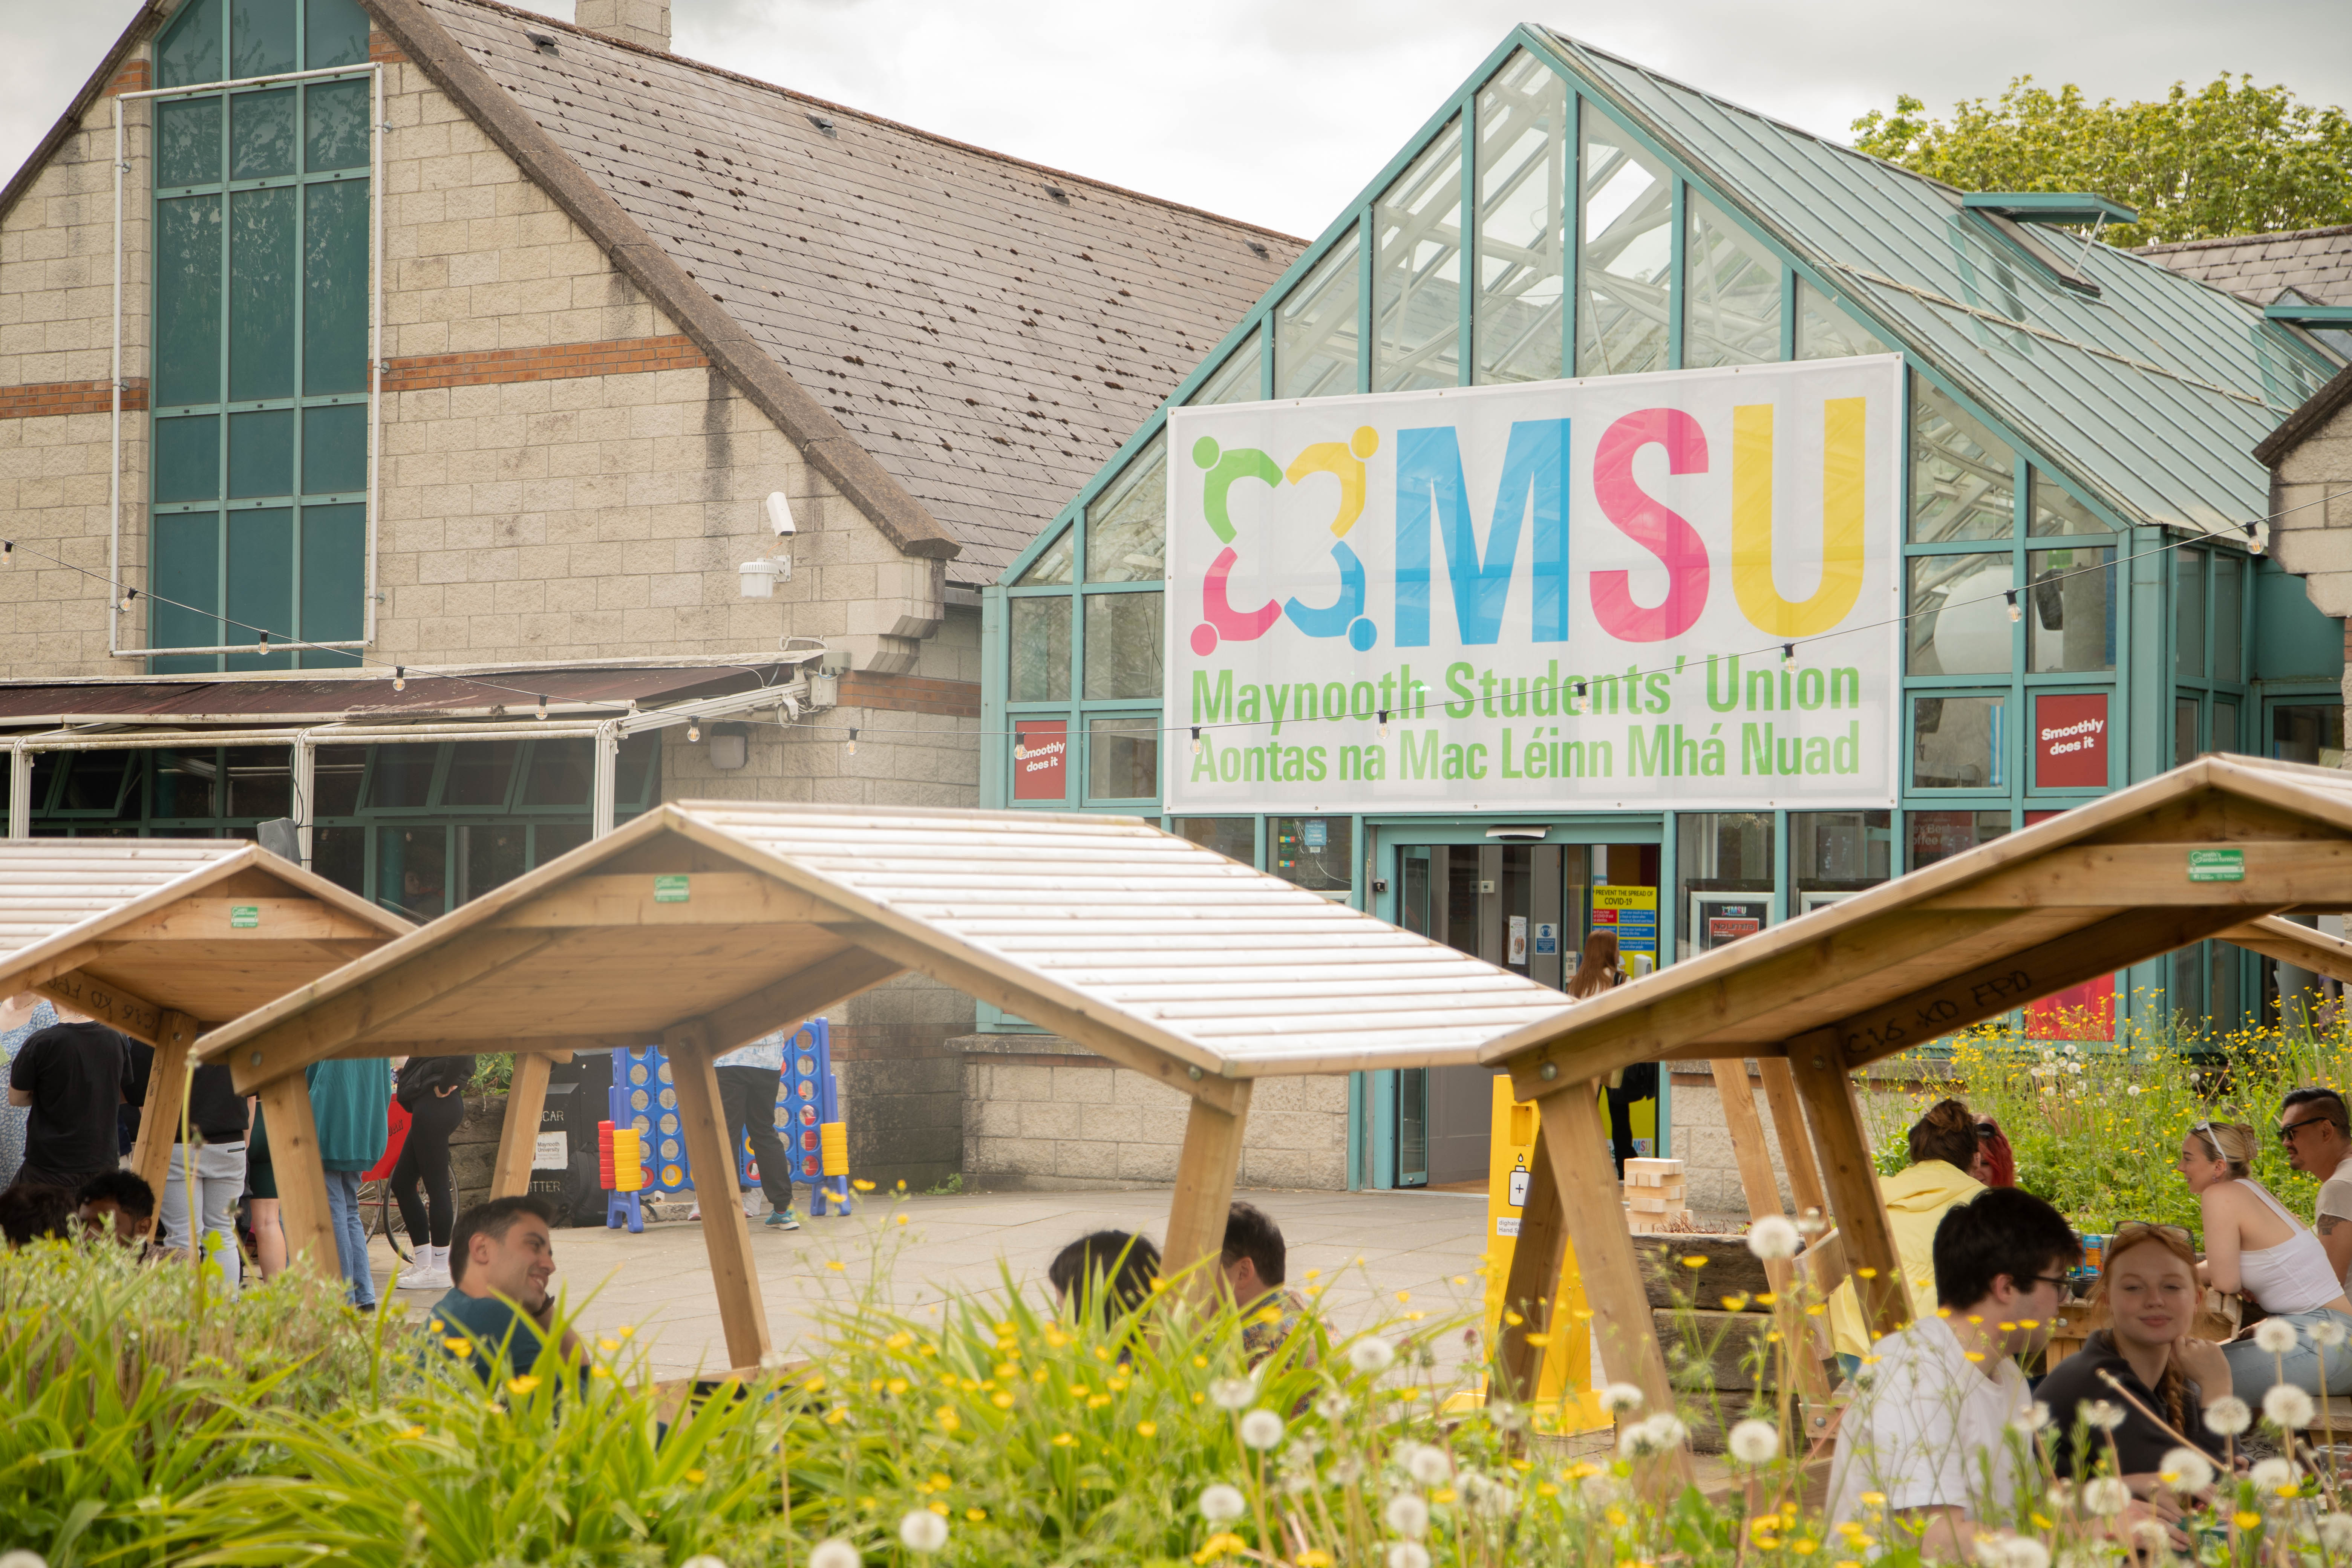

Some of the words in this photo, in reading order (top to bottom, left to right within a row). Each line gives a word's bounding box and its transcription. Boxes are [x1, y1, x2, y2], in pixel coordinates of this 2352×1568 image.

[1395, 397, 1866, 648] MSU
[1192, 664, 1426, 736] Maynooth
[1706, 653, 1859, 713] Union
[2041, 718, 2104, 741] Smoothly
[1190, 733, 1327, 782] Aontas
[1339, 744, 1385, 781] na
[1400, 729, 1487, 780] Mac
[1502, 726, 1612, 779] Léinn
[1628, 722, 1725, 778] Mhá
[1741, 720, 1859, 775] Nuad
[2050, 741, 2081, 755] does
[2083, 736, 2094, 749] it
[1026, 761, 1049, 772] does
[1050, 756, 1058, 767] it
[1913, 836, 1938, 845] offee
[1730, 906, 1747, 914] MSU
[1634, 1140, 1651, 1152] MSU
[528, 1181, 561, 1192] ITTER
